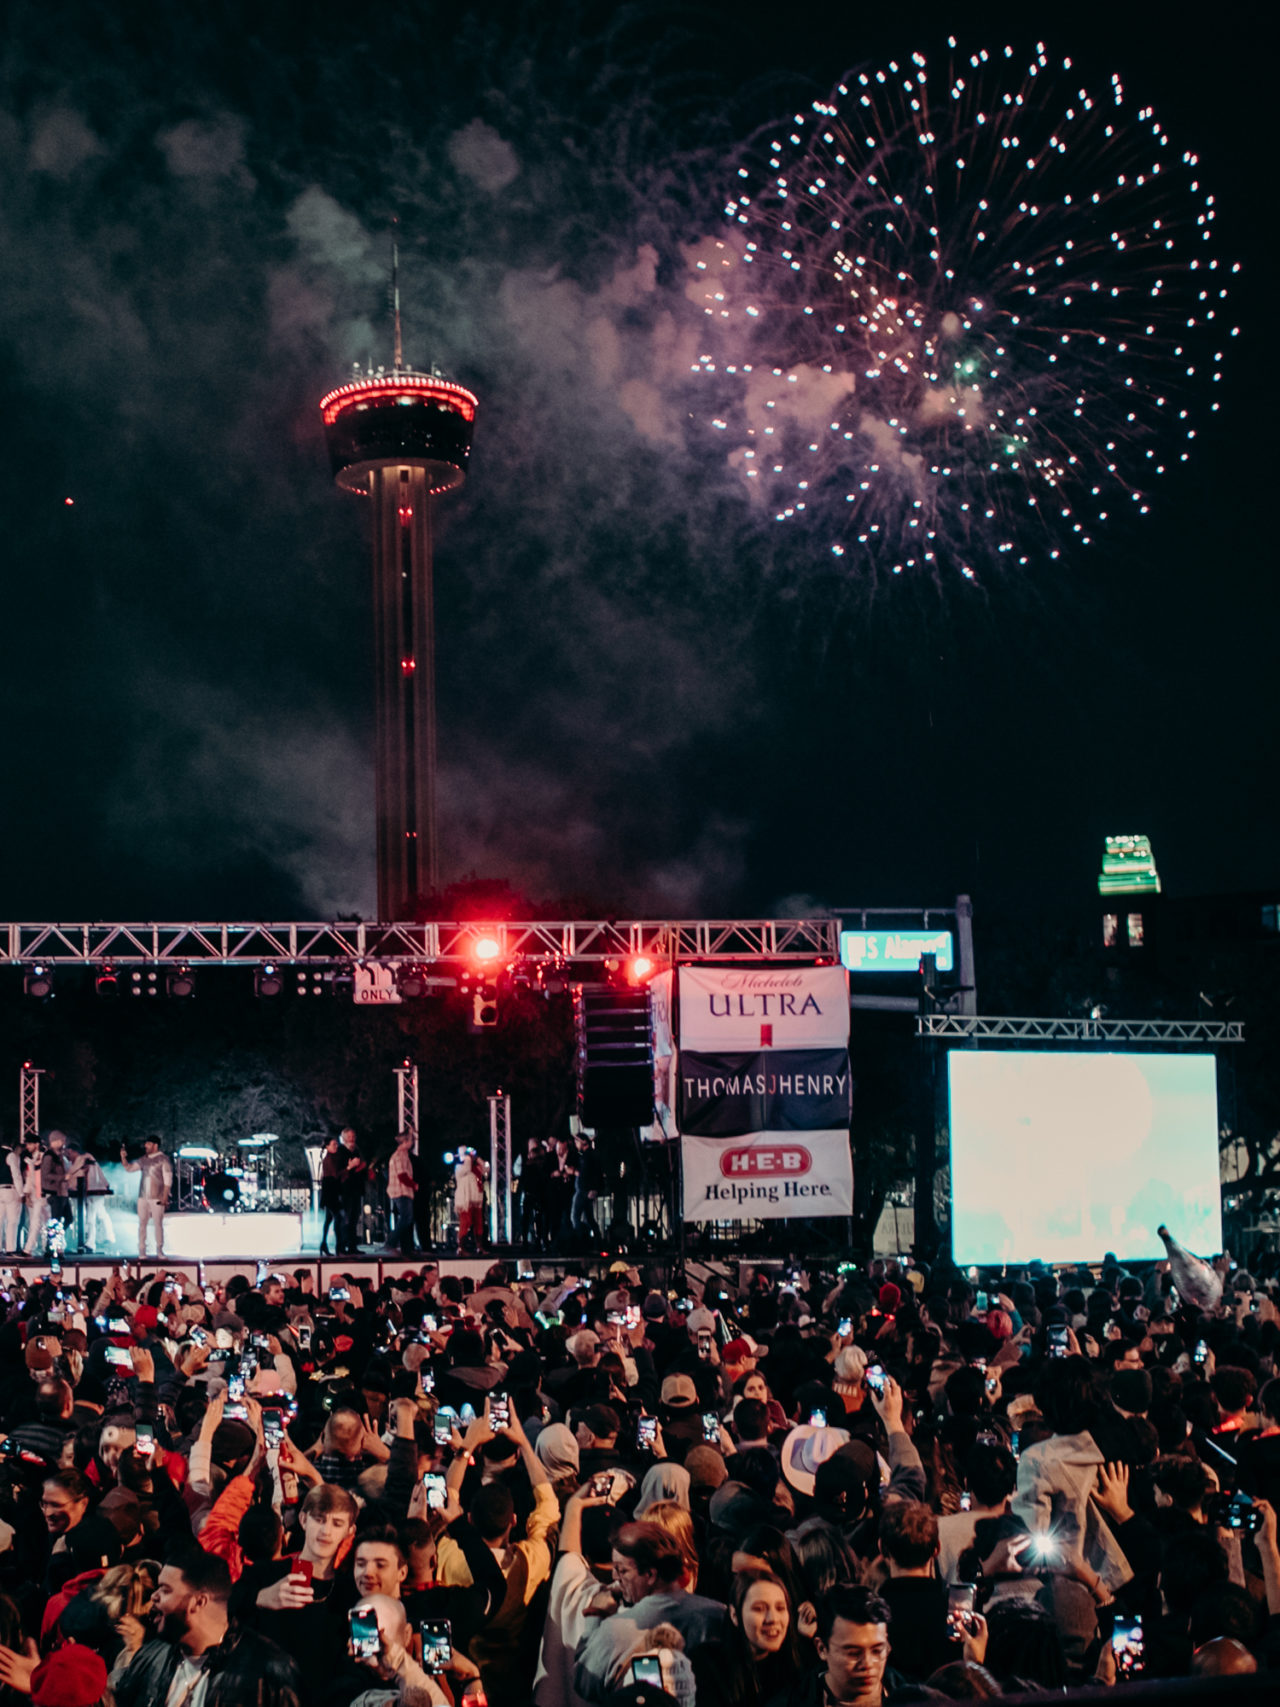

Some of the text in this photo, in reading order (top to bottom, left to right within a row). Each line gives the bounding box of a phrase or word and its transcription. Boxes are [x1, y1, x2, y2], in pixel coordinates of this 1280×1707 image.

[720, 974, 804, 989] Michelob
[362, 989, 394, 1002] ONLY
[710, 994, 822, 1016] ULTRA
[705, 1184, 779, 1204] Helping
